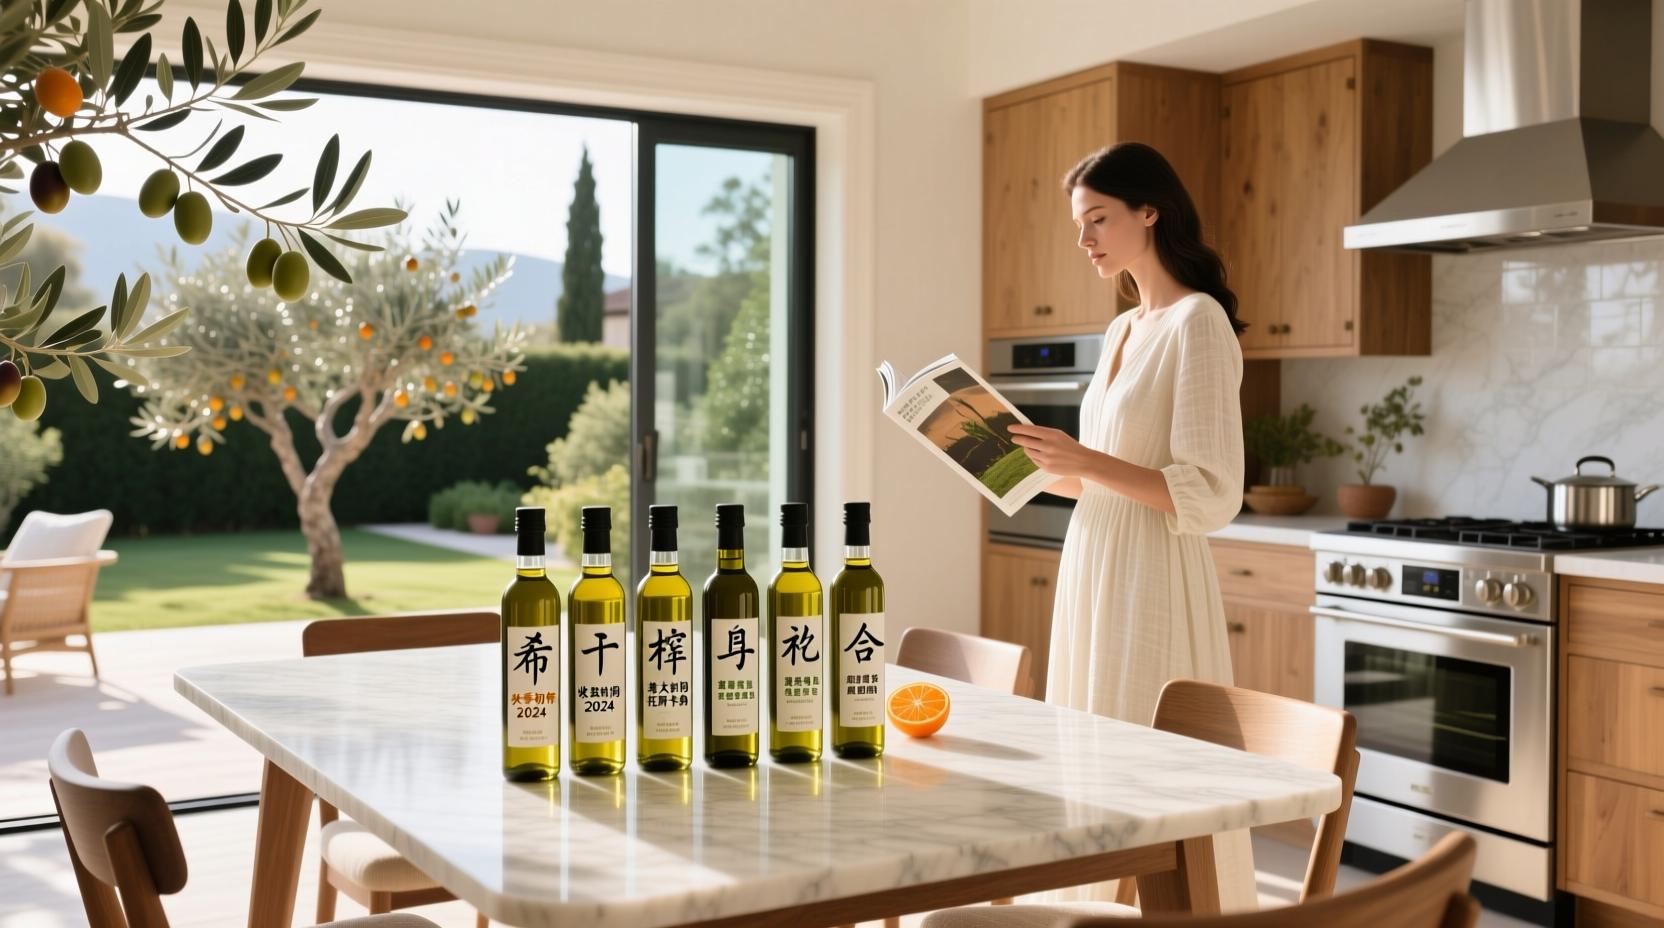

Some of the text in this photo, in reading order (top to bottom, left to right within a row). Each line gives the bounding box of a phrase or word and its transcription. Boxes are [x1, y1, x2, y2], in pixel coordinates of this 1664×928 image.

[844, 622, 884, 663] 合
[513, 631, 552, 686] 希
[516, 706, 547, 718] 2024
[584, 700, 615, 712] 2024
